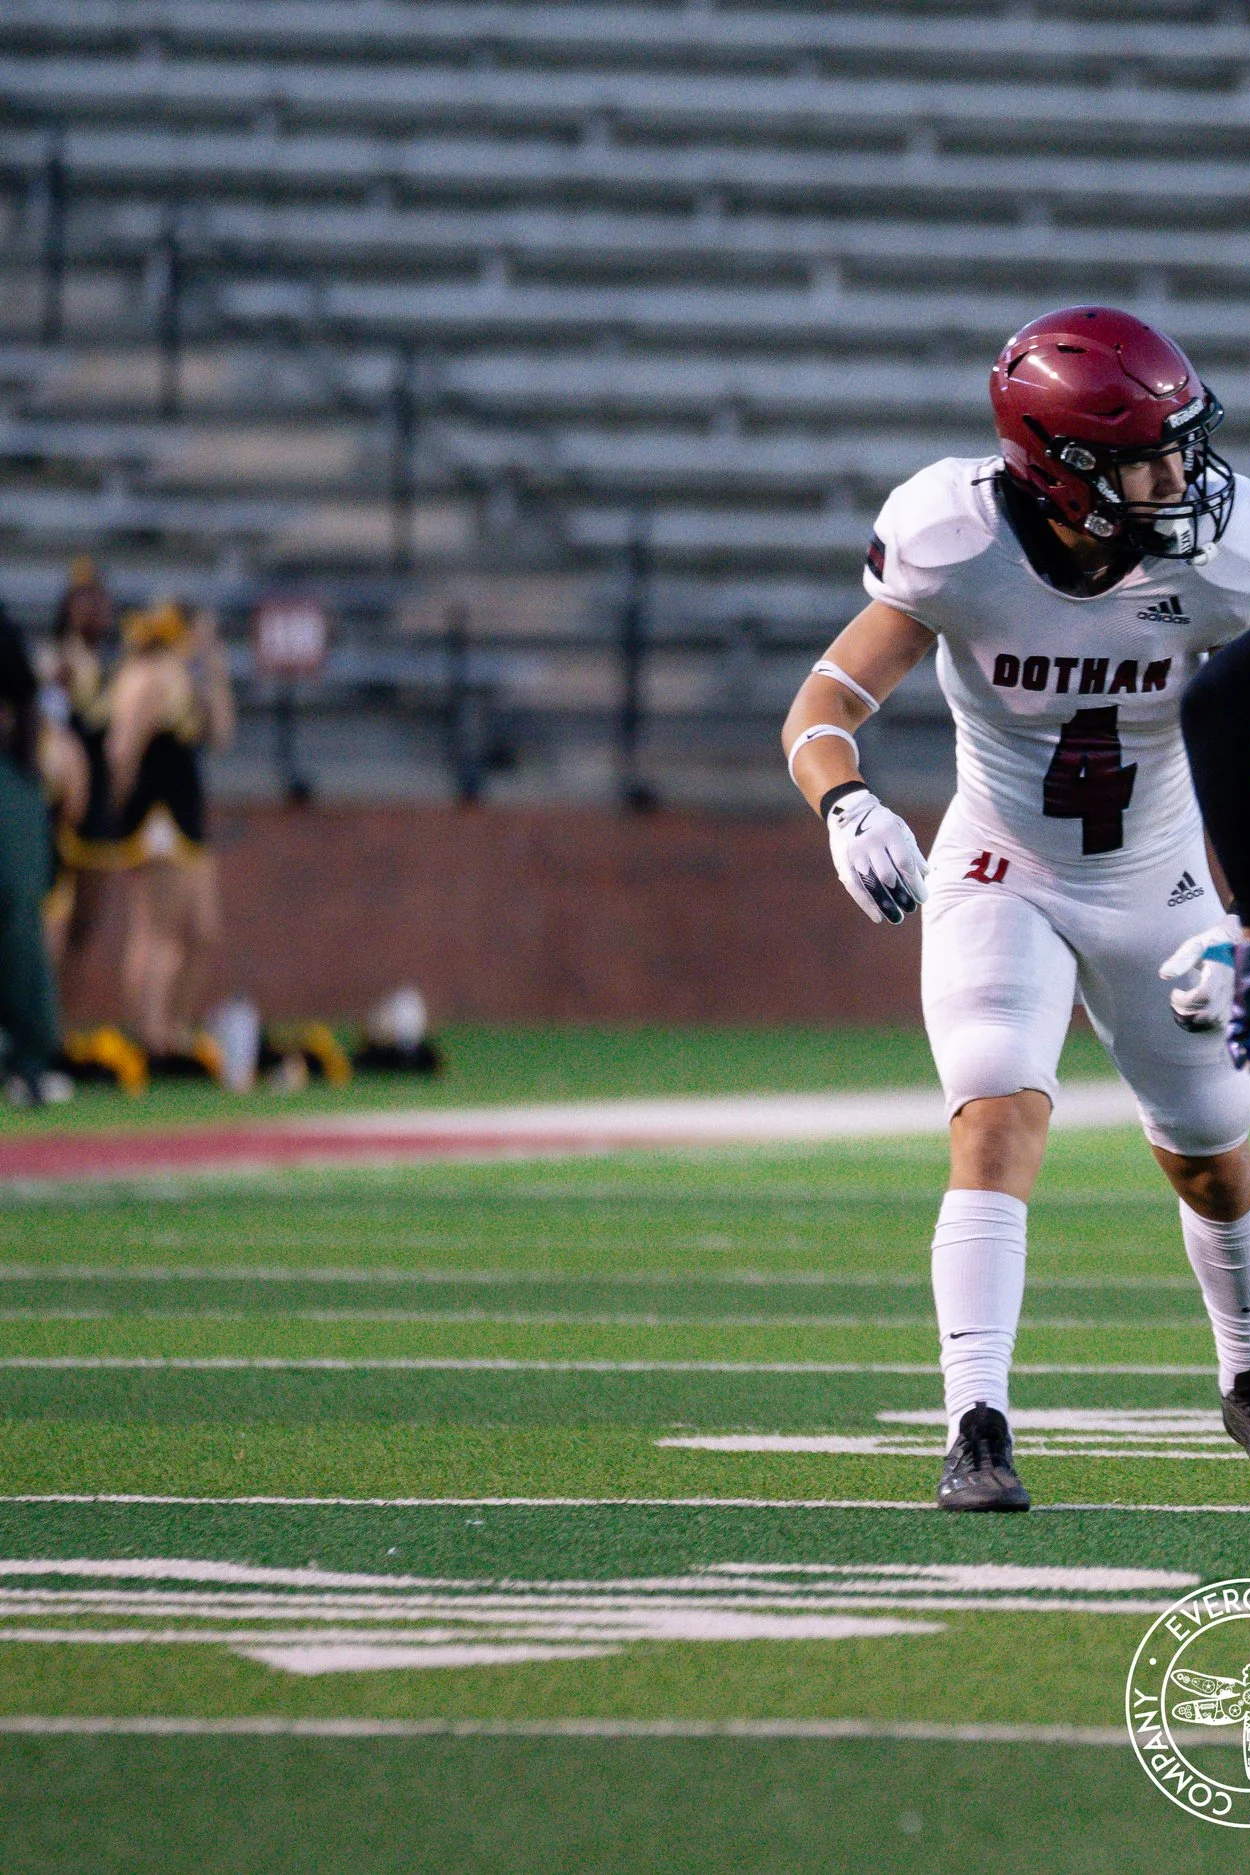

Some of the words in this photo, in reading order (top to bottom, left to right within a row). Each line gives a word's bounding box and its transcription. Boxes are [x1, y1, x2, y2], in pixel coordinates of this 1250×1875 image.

[1137, 611, 1191, 625] adidas
[993, 653, 1172, 695] DOTHAN
[1043, 704, 1138, 855] 4
[1168, 887, 1204, 907] adidas
